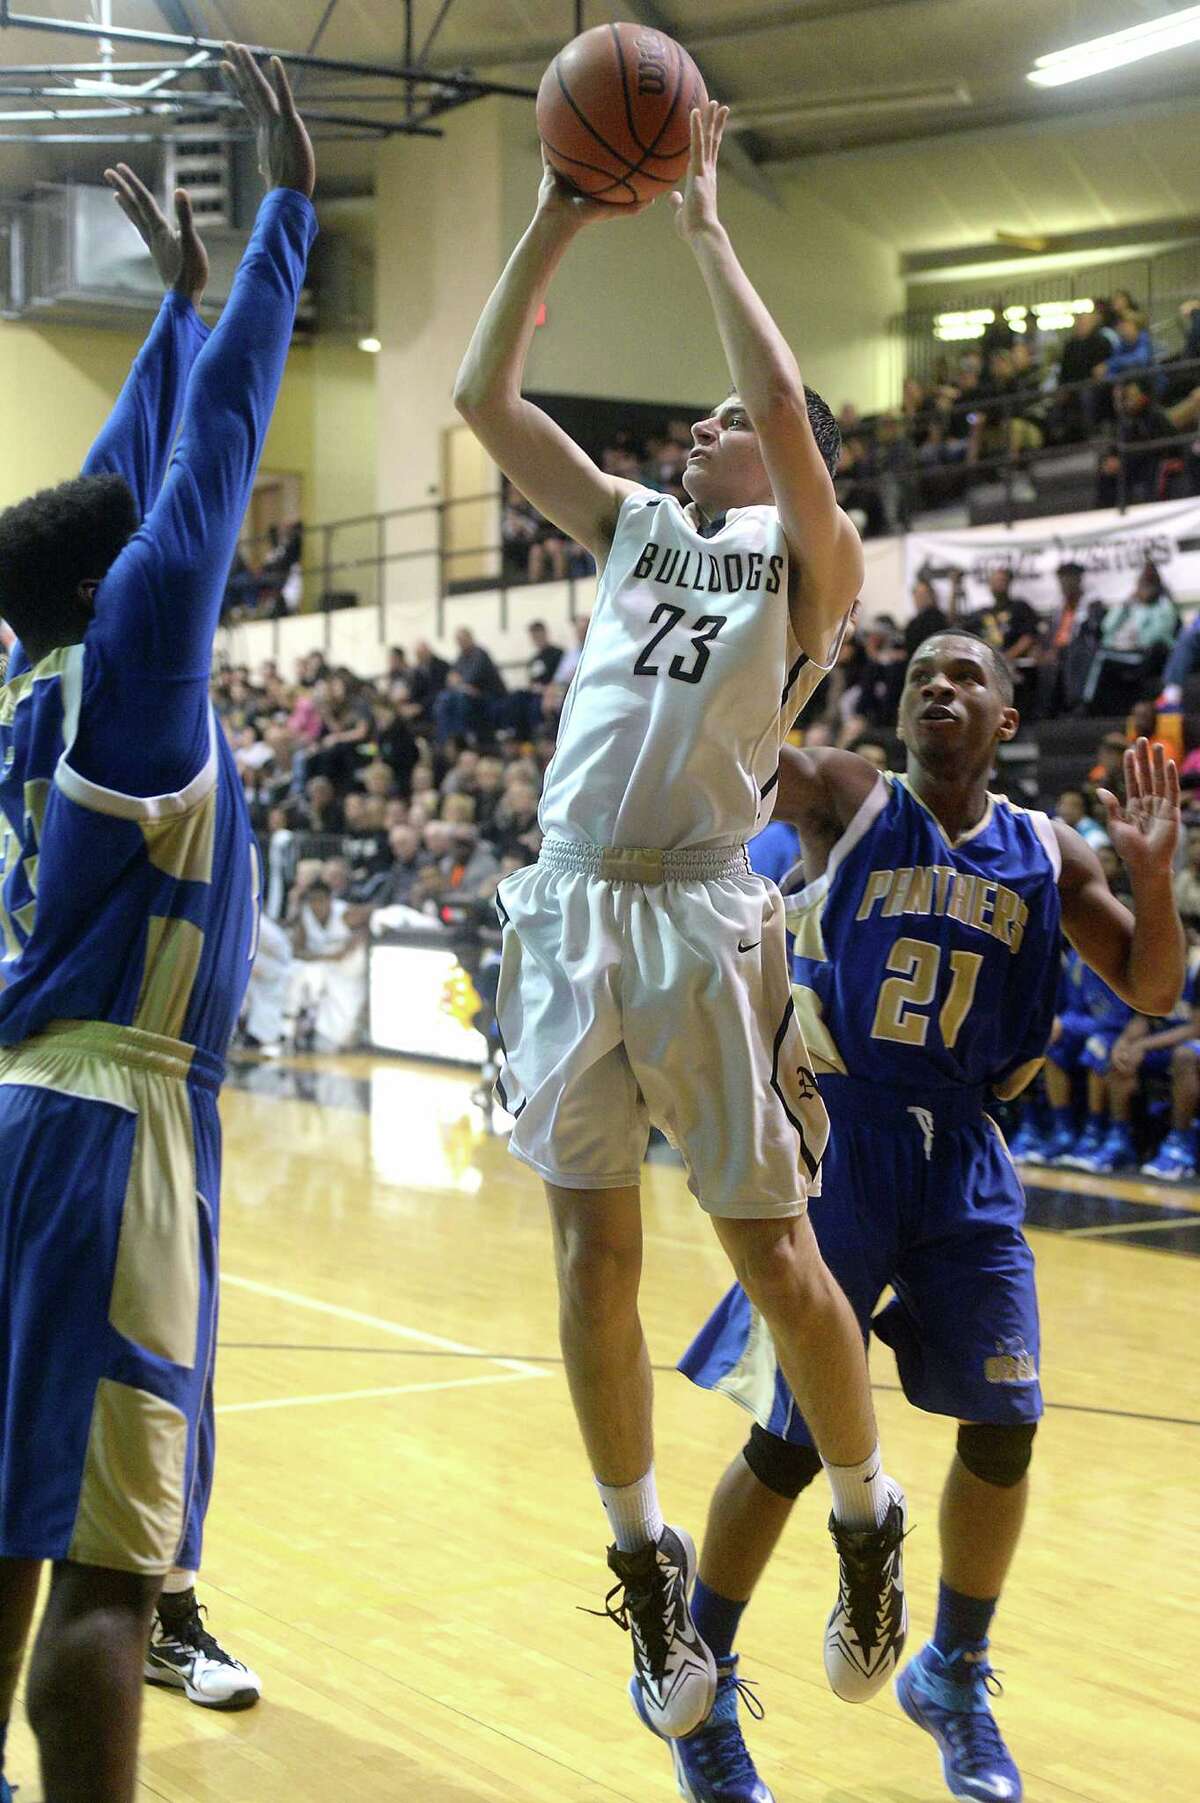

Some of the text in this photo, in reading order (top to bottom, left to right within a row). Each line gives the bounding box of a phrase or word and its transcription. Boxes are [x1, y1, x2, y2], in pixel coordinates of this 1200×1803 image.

[632, 541, 784, 595] BULLDOGS
[633, 602, 728, 684] 23
[855, 864, 1030, 955] PANTHERS
[869, 936, 985, 1049] 21
